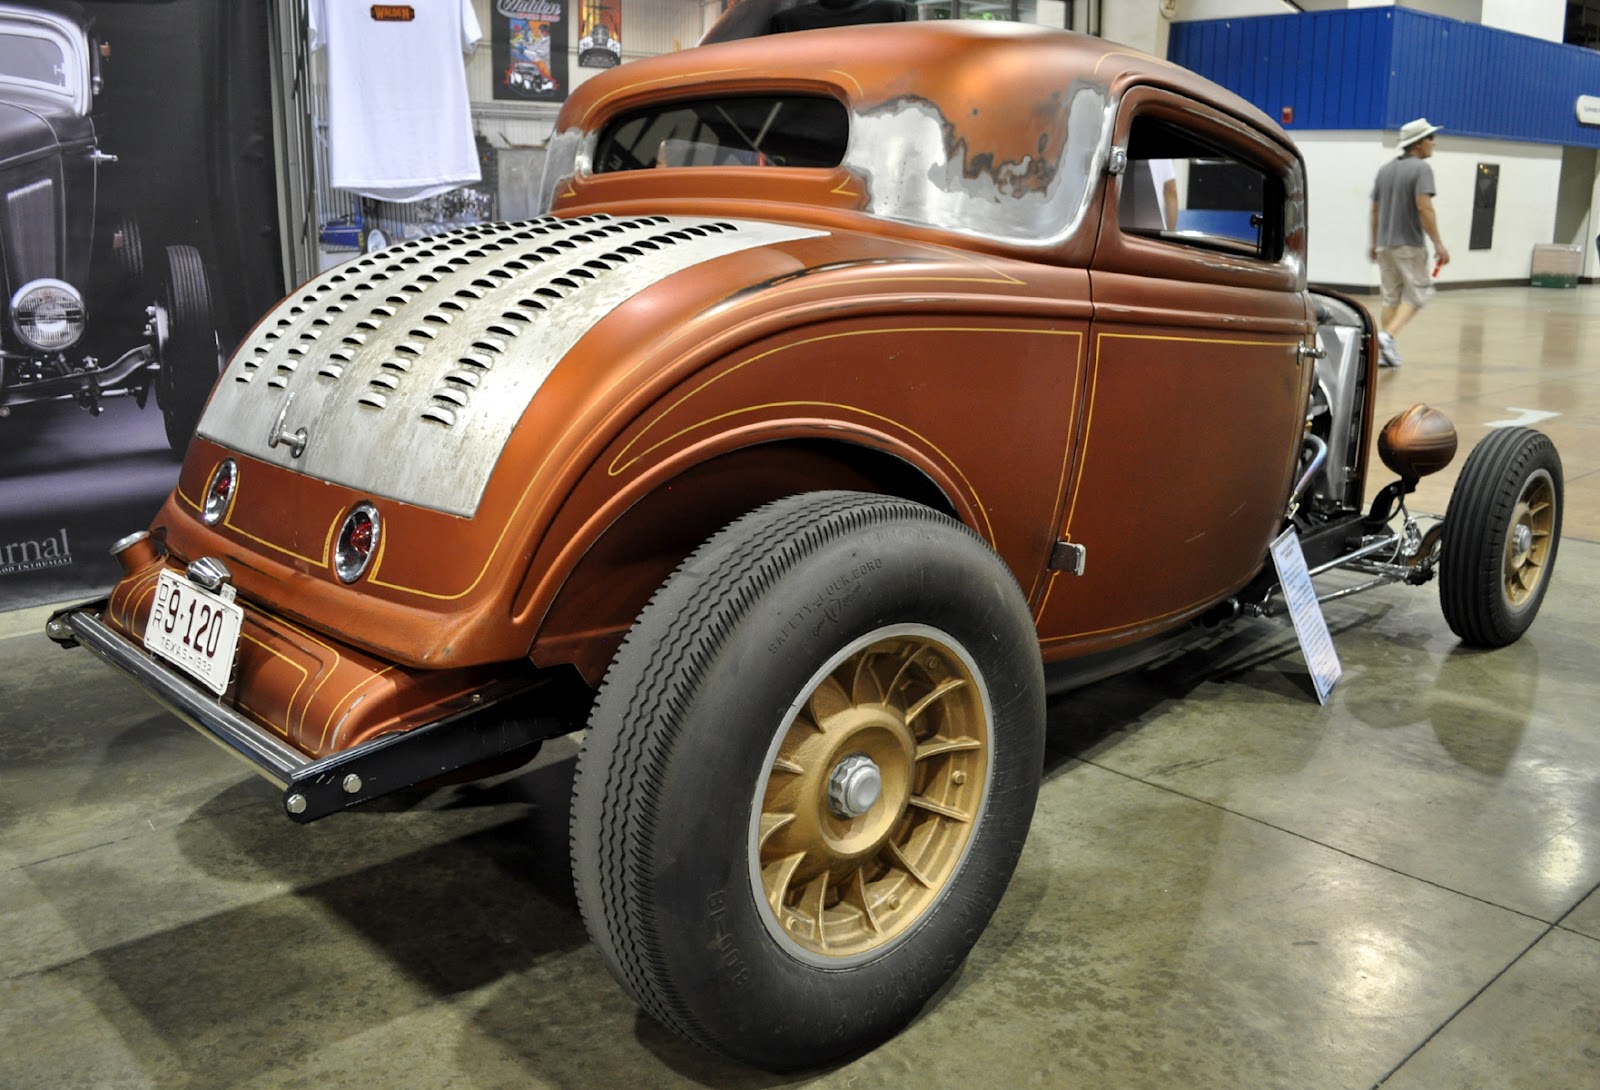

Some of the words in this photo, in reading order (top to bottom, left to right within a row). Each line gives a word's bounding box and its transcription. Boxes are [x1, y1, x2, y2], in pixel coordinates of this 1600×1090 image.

[374, 6, 410, 20] WALDEN
[0, 528, 71, 566] rnal
[18, 557, 73, 571] ENTHUSIAST
[852, 558, 883, 580] CORD
